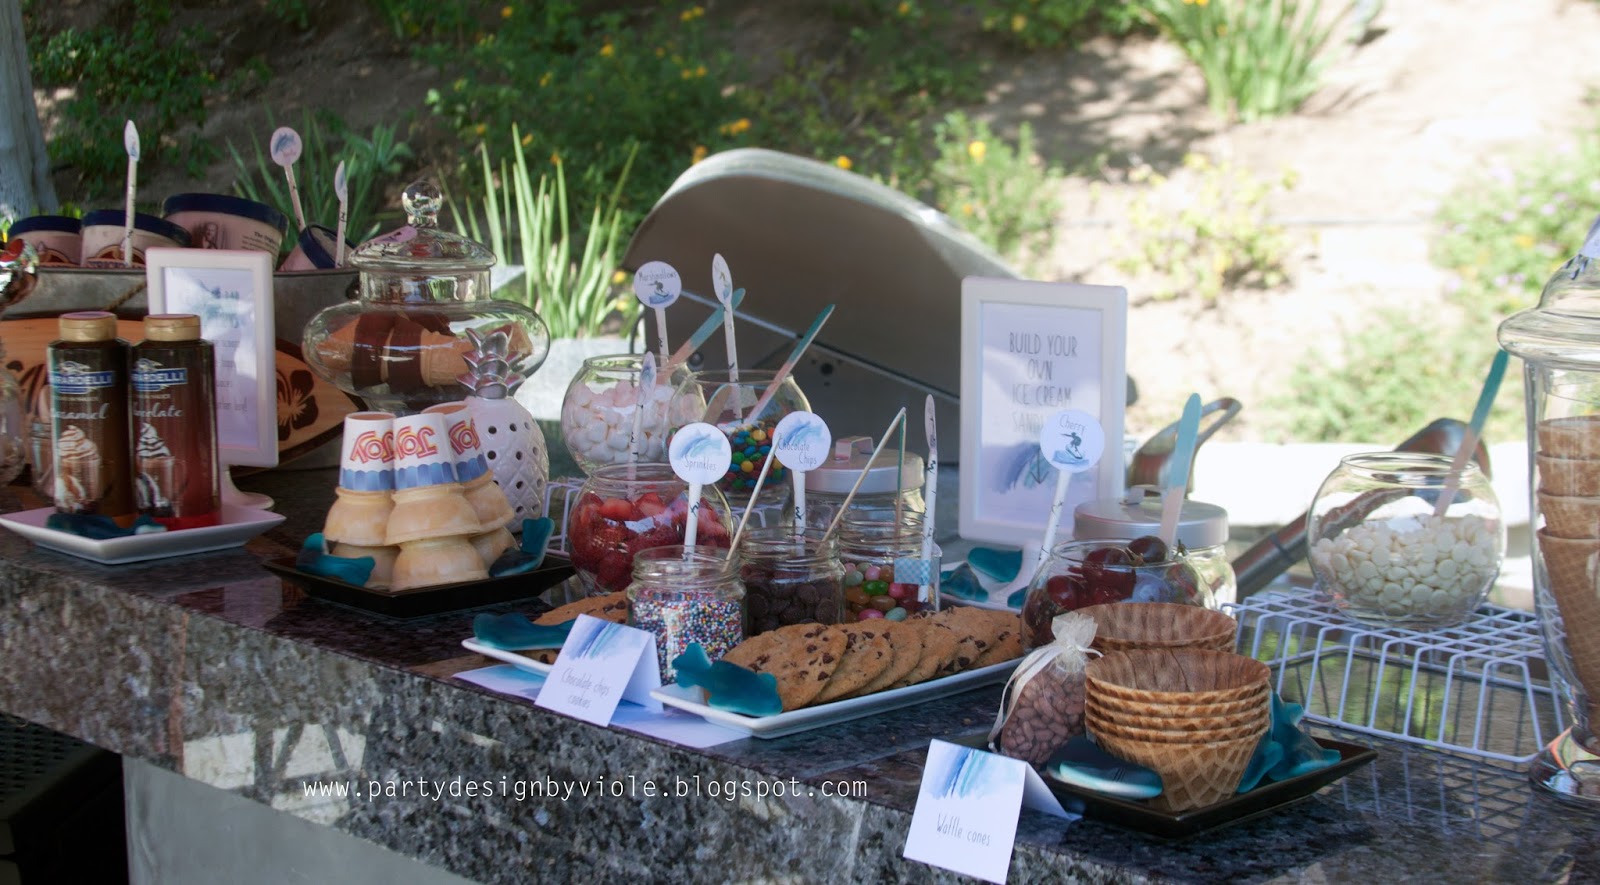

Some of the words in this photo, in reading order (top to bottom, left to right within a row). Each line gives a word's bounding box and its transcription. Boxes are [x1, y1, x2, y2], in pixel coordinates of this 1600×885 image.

[638, 268, 677, 282] Marshmallows
[1009, 332, 1041, 354] BUILD
[1047, 335, 1078, 357] YOUR
[1028, 358, 1053, 380] OWN
[1012, 384, 1031, 405] ICE
[1036, 386, 1073, 407] CREAM
[1059, 414, 1087, 436] Cherry
[778, 433, 810, 451] Chocolate
[684, 454, 717, 471] Sprinkles
[799, 451, 818, 467] Chips
[561, 667, 593, 690] Chocolate
[936, 813, 962, 839] Waffle
[967, 830, 991, 847] cones
